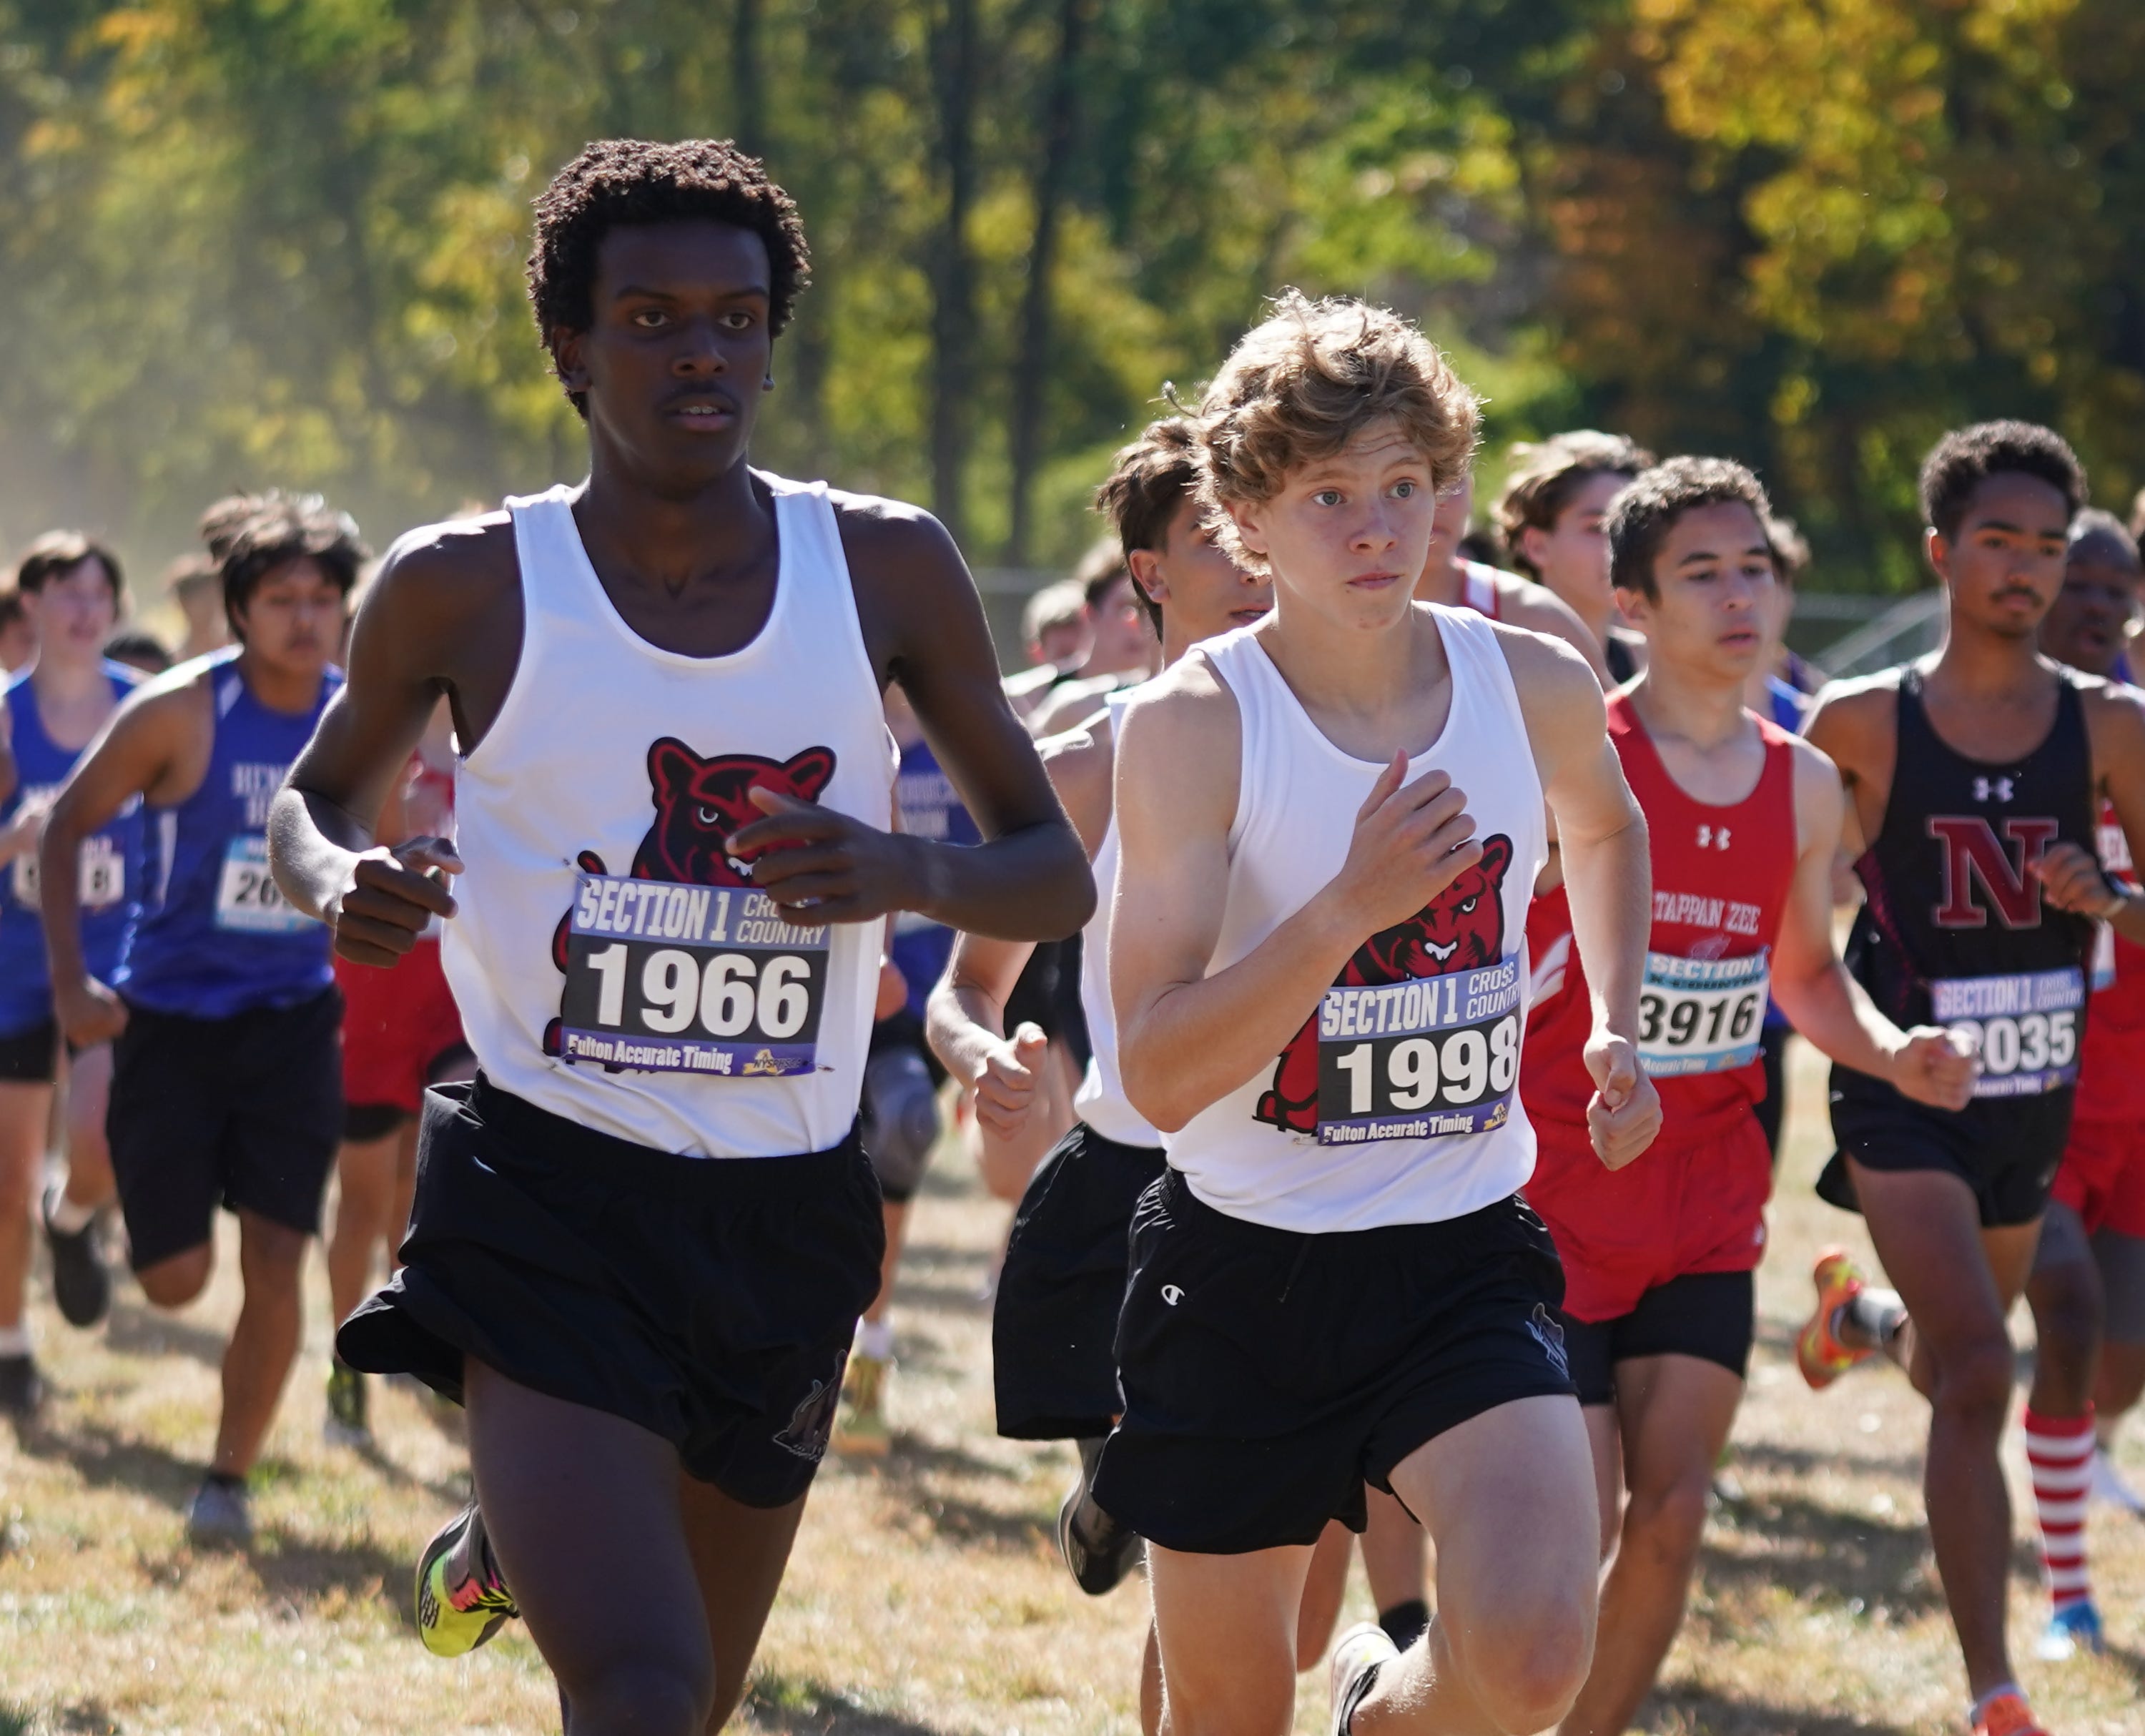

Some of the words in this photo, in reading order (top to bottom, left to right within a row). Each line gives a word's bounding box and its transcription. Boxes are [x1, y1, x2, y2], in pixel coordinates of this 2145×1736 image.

[576, 878, 711, 941] SECTION
[710, 892, 731, 942] 1
[1653, 890, 1725, 928] TAPPAN
[1727, 902, 1760, 935] ZEE
[736, 919, 826, 945] COUNTRY
[1468, 961, 1514, 995] CROSS
[1650, 955, 1755, 980] SECTION
[587, 943, 812, 1039] 1966
[1322, 981, 1440, 1037] SECTION
[1443, 977, 1459, 1025] 1
[1936, 977, 2020, 1018] SECTION
[1639, 992, 1760, 1046] 3916
[568, 1034, 613, 1062] Fulton
[613, 1040, 682, 1067] Accurate
[681, 1045, 734, 1075] Timing
[1337, 1015, 1517, 1115] 1998
[1323, 1125, 1366, 1144] Fulton
[1366, 1120, 1429, 1140] Accurate
[1429, 1115, 1474, 1134] Timing
